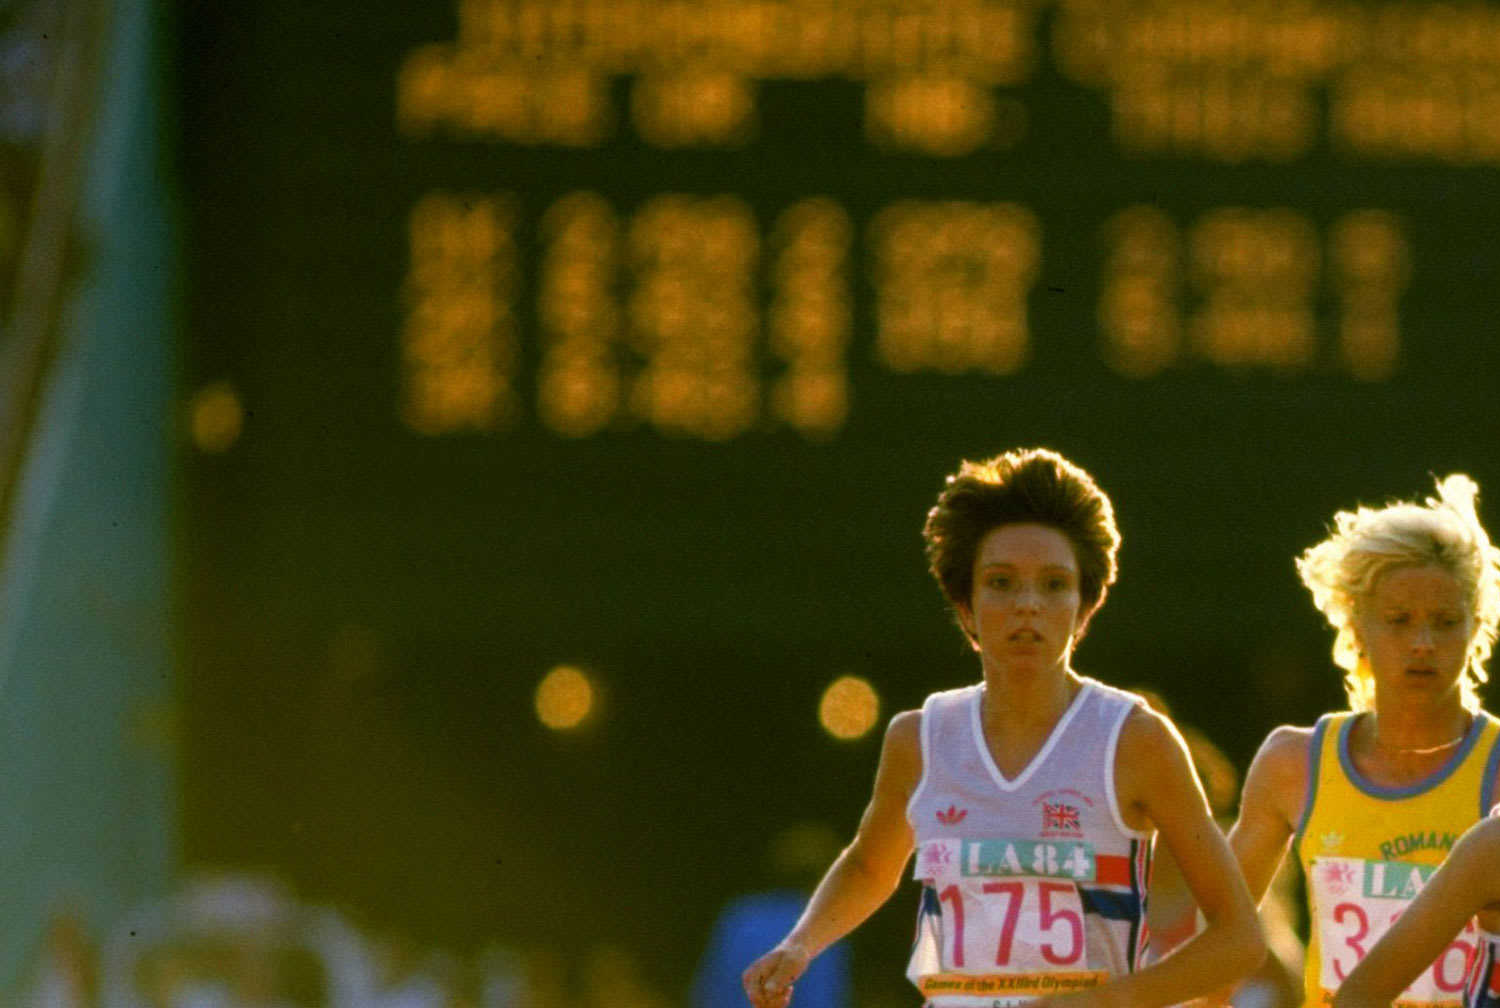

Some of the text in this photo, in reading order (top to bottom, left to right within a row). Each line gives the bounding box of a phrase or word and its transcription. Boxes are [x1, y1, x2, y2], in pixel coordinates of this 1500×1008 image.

[968, 842, 1092, 878] LA 84
[939, 881, 1085, 967] 175
[1334, 903, 1475, 993] 36
[925, 978, 961, 991] Games
[977, 978, 994, 992] the
[1042, 975, 1098, 990] Olympiad
